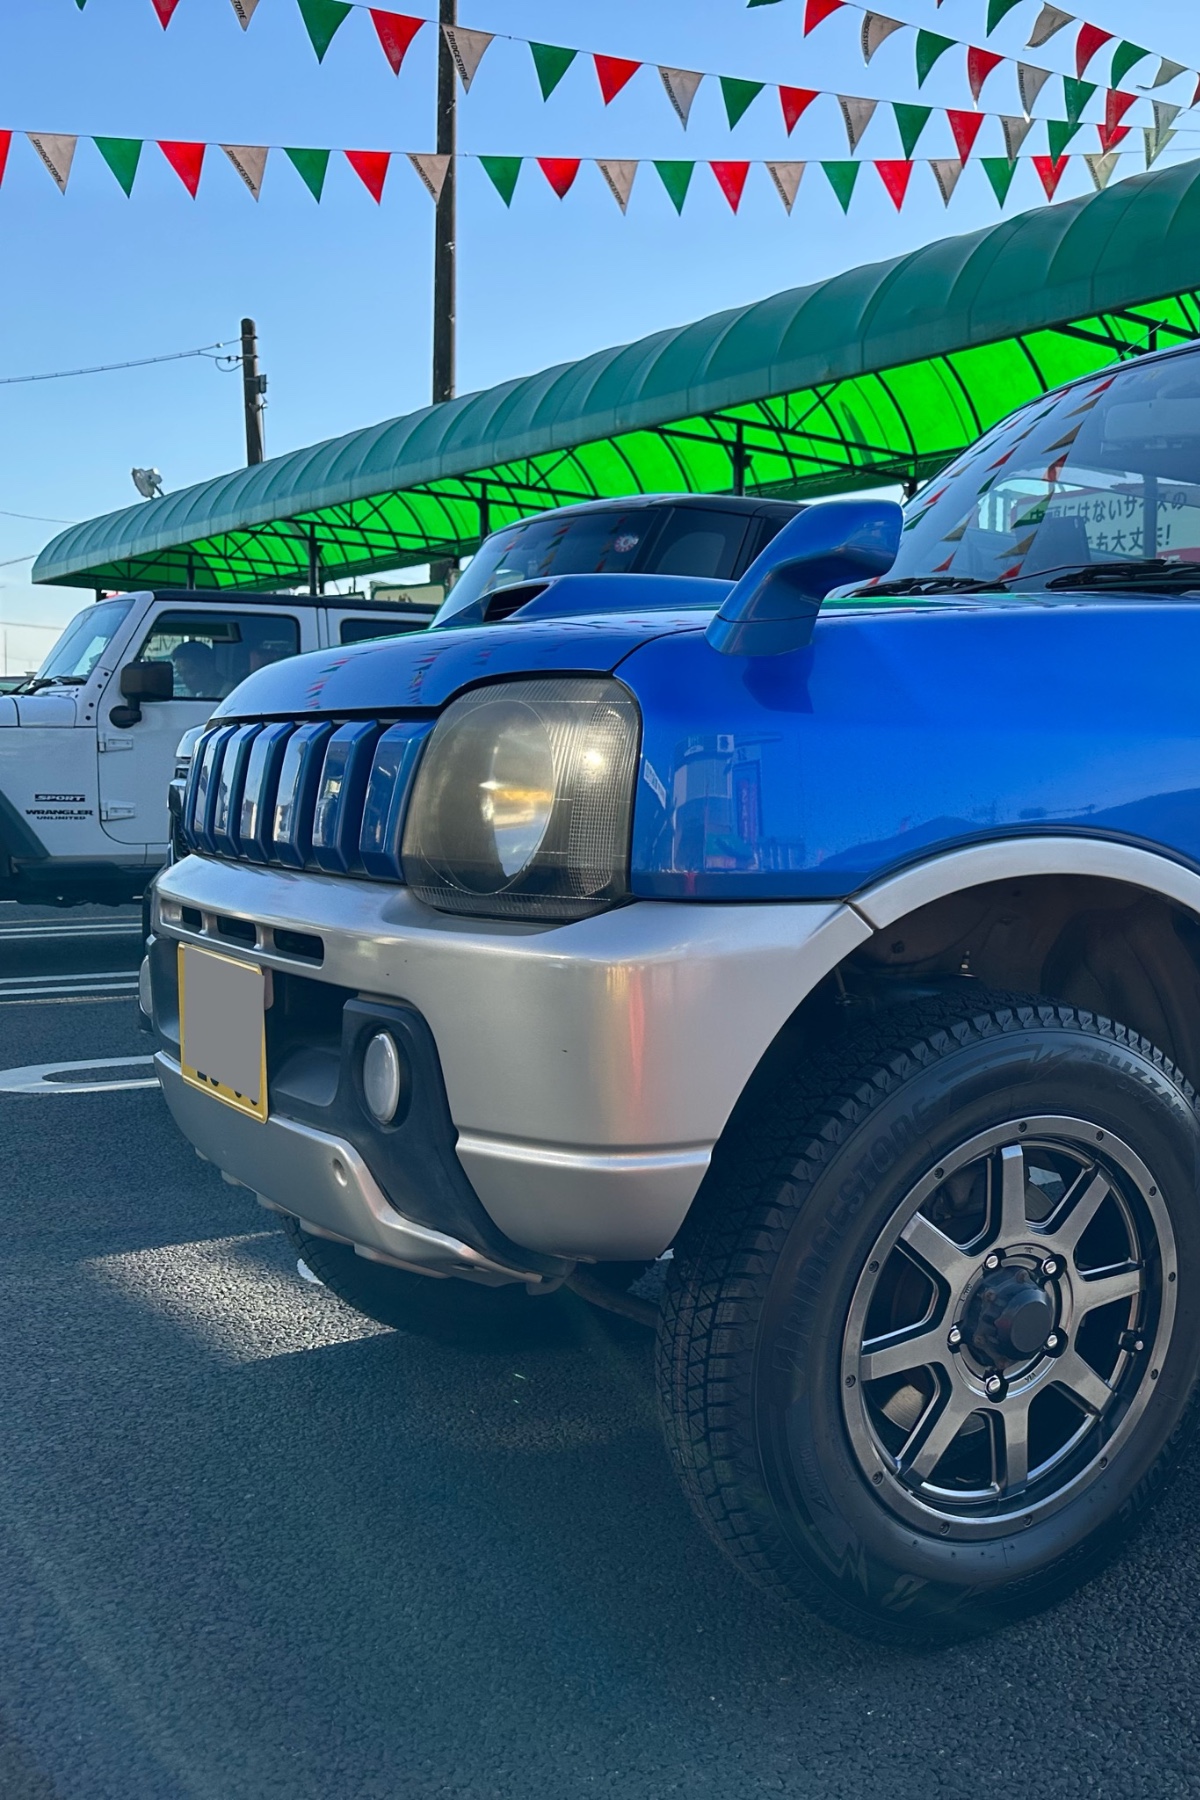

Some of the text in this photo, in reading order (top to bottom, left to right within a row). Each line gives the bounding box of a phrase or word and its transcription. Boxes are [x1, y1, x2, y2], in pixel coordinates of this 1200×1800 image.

[448, 31, 469, 81] BRIDGESTONE
[33, 139, 64, 183] BRIDGESTONE
[226, 150, 257, 190] BRIDGESTONE
[411, 155, 437, 195] BRIDGESTONE
[1090, 1046, 1187, 1123] BLIZZAK
[771, 1095, 939, 1380] BRIDGESTONE
